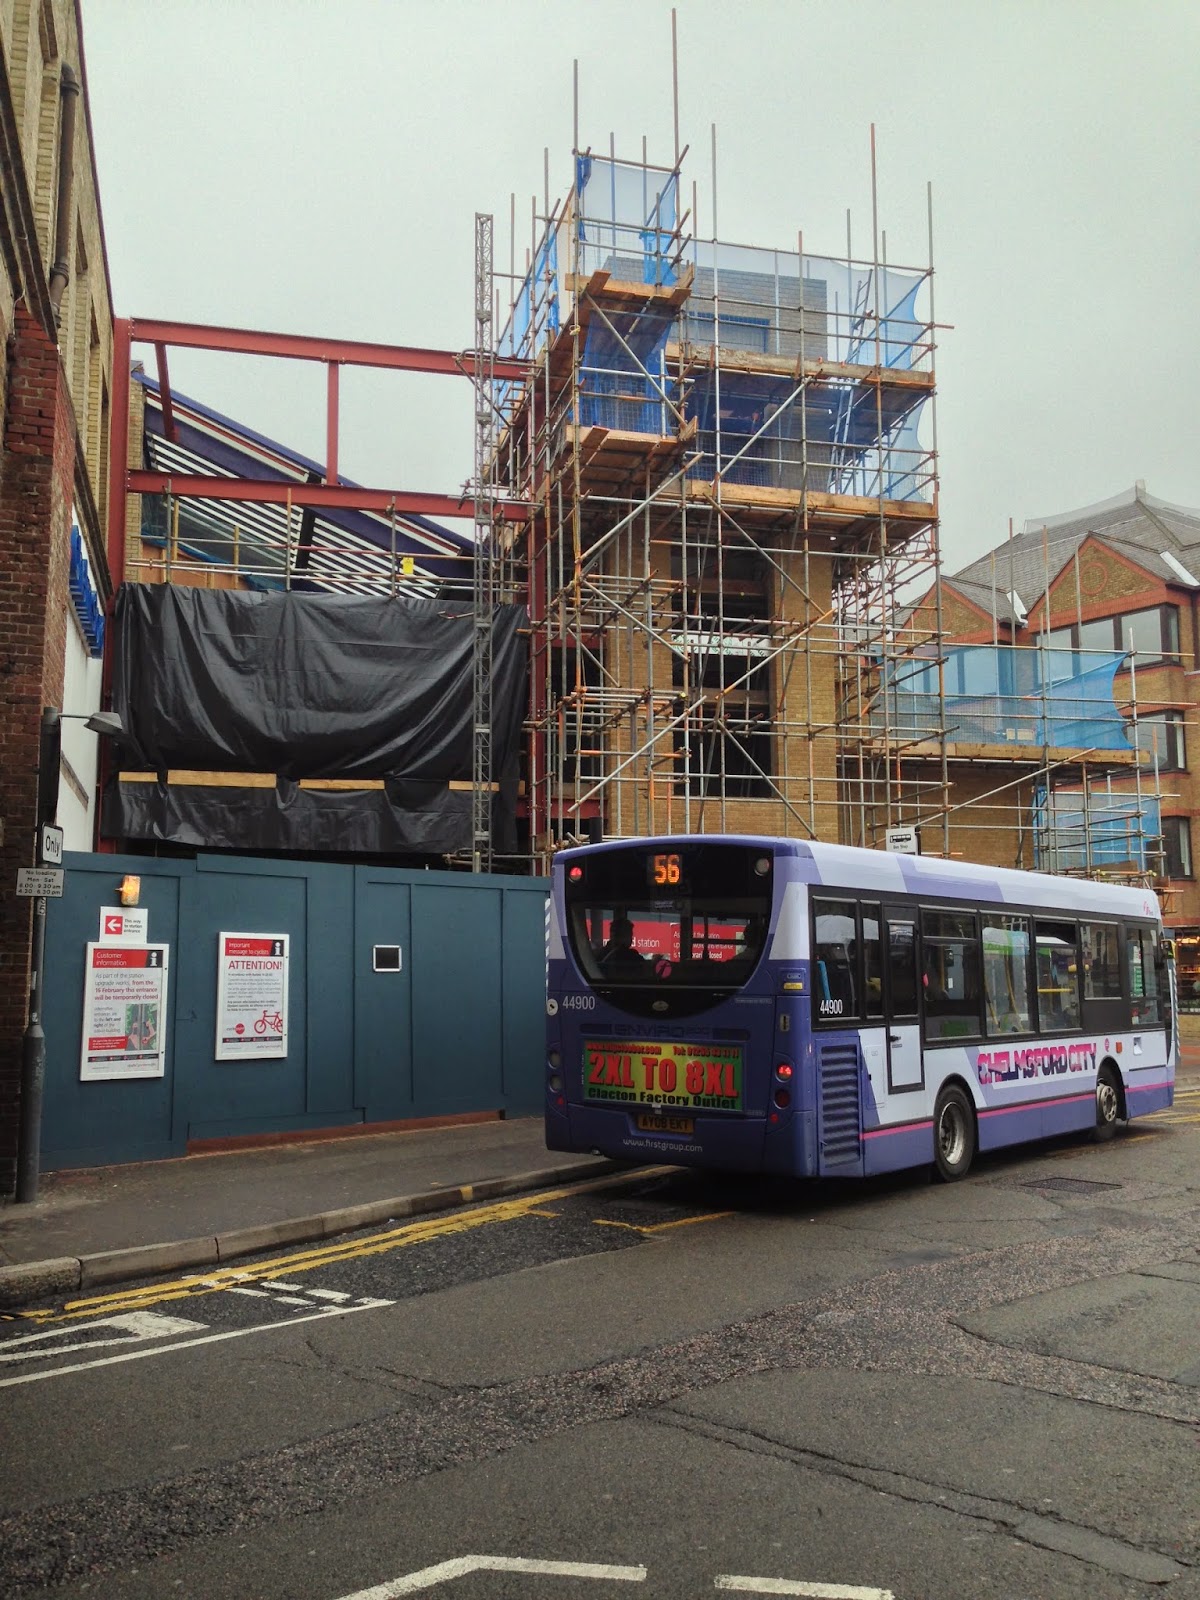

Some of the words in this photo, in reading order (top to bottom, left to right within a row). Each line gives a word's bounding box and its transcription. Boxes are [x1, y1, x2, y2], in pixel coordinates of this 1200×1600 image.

[45, 834, 60, 857] Only
[654, 854, 680, 883] 56
[638, 937, 660, 947] station
[228, 960, 282, 970] ATTENTION!
[562, 996, 595, 1010] 44900
[820, 1000, 843, 1014] 44900
[977, 1045, 1067, 1084] CHELMSFORD
[1068, 1043, 1096, 1072] CITY
[588, 1052, 634, 1088] 2XL
[642, 1056, 676, 1092] TO
[686, 1060, 738, 1098] 8XL
[588, 1087, 636, 1101] Clacton
[640, 1092, 689, 1106] Factory
[693, 1094, 736, 1110] Outlet
[623, 1138, 703, 1152] www.firstgroup.com
